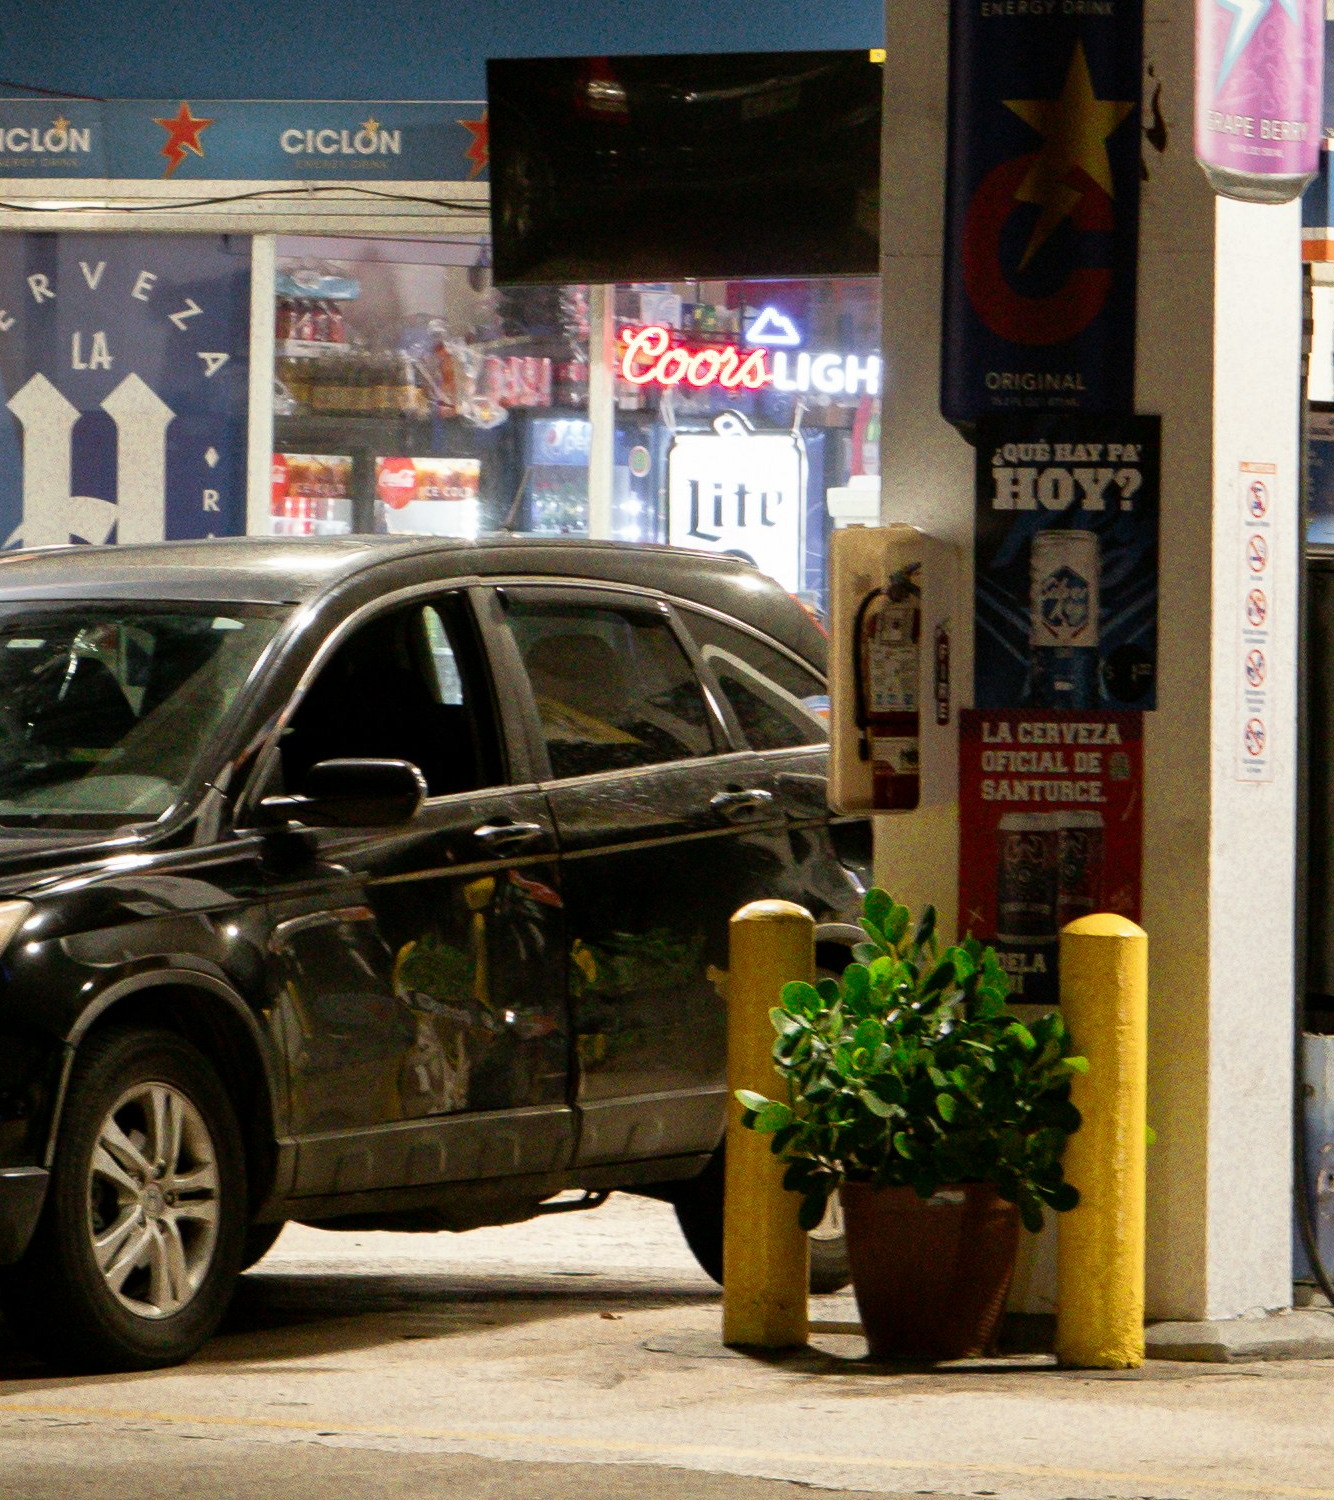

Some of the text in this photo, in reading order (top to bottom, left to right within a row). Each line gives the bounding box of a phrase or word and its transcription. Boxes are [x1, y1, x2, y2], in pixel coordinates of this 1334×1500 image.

[71, 331, 114, 370] LA
[622, 326, 881, 395] Coors LIGH
[984, 371, 1087, 391] ORIGINAL
[1053, 443, 1103, 463] HAY
[202, 489, 220, 511] R
[991, 466, 1144, 511] HOY?
[687, 479, 783, 542] Lite
[982, 722, 1123, 746] LA CERVEZA
[981, 750, 1103, 774] OFICIAL DE
